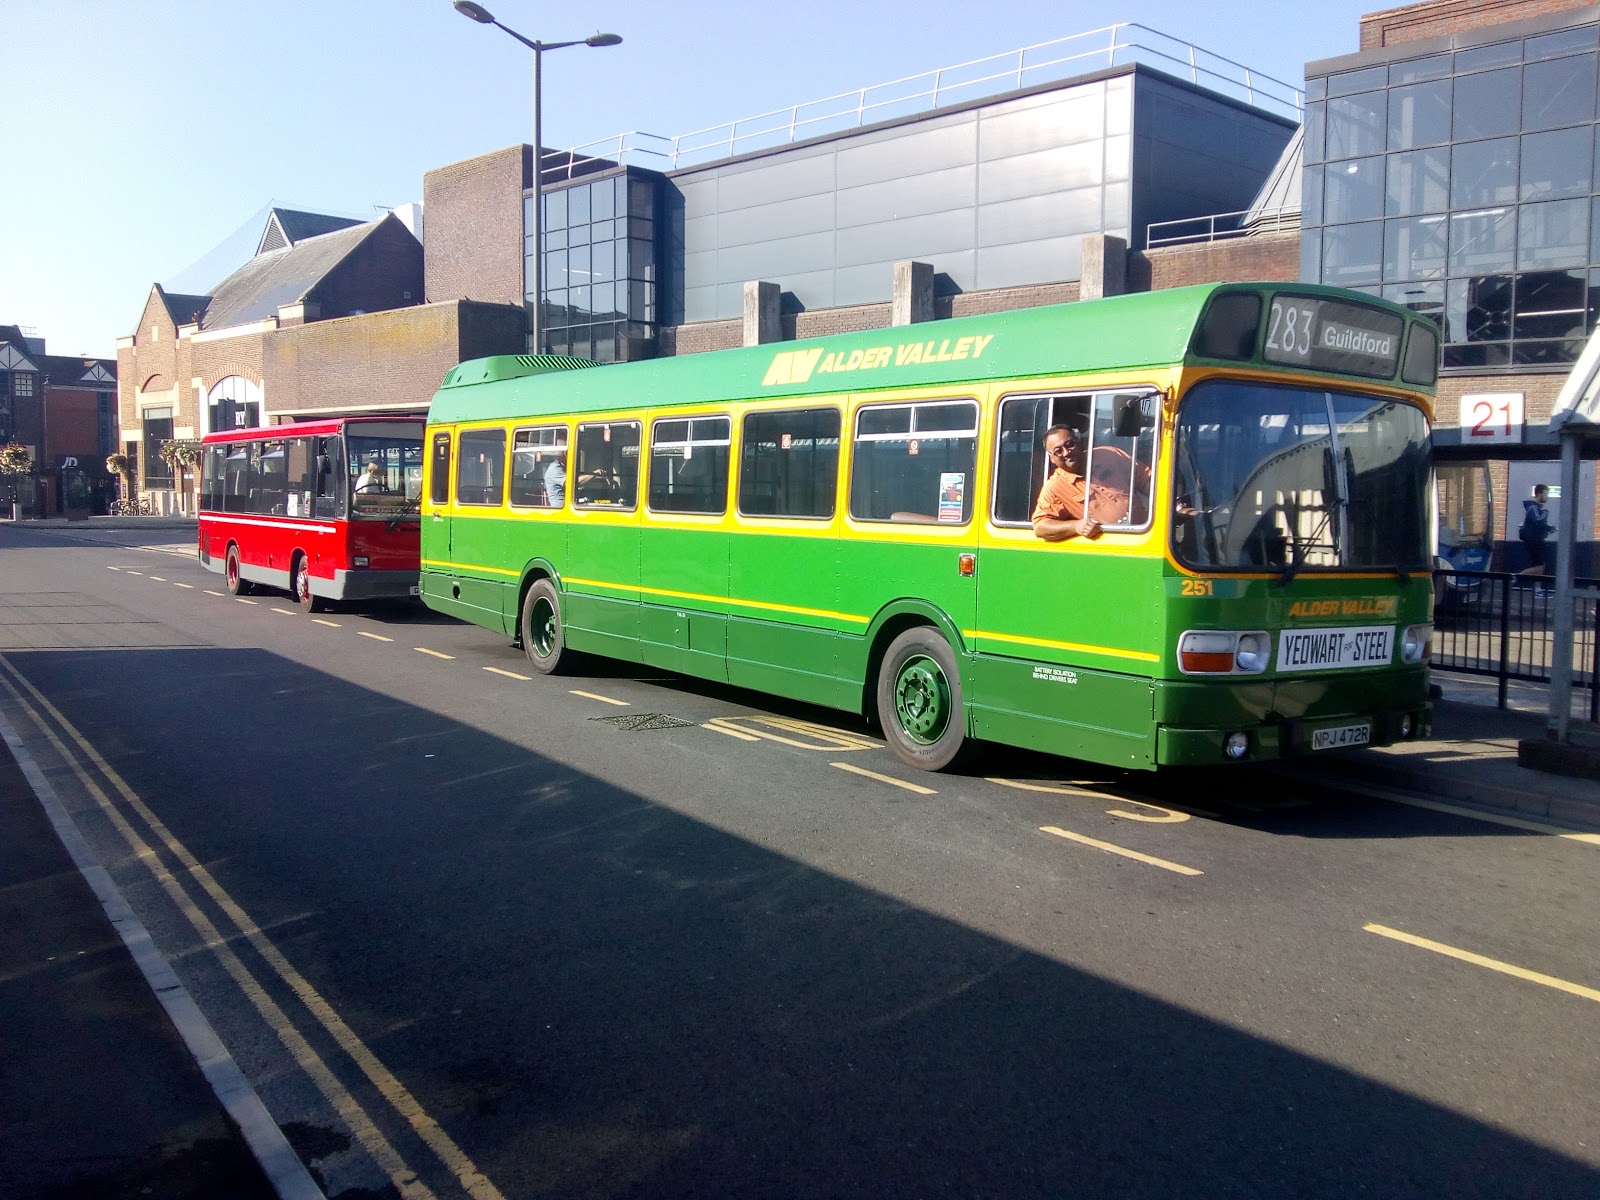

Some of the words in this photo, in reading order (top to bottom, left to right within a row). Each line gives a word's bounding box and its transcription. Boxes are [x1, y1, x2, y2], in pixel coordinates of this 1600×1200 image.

[1265, 303, 1314, 355] 283
[1324, 326, 1391, 355] Guildford
[817, 346, 893, 374] ALDER
[895, 334, 994, 366] VALLEY
[1471, 400, 1512, 436] 21
[61, 456, 78, 469] JD
[1181, 579, 1214, 596] 251
[1289, 600, 1338, 616] ALDER
[1341, 599, 1393, 614] VALLEY
[1285, 633, 1346, 666] YEOWART
[1353, 631, 1388, 661] STEEL
[1314, 731, 1338, 748] NPJ
[1340, 726, 1369, 744] 472R
